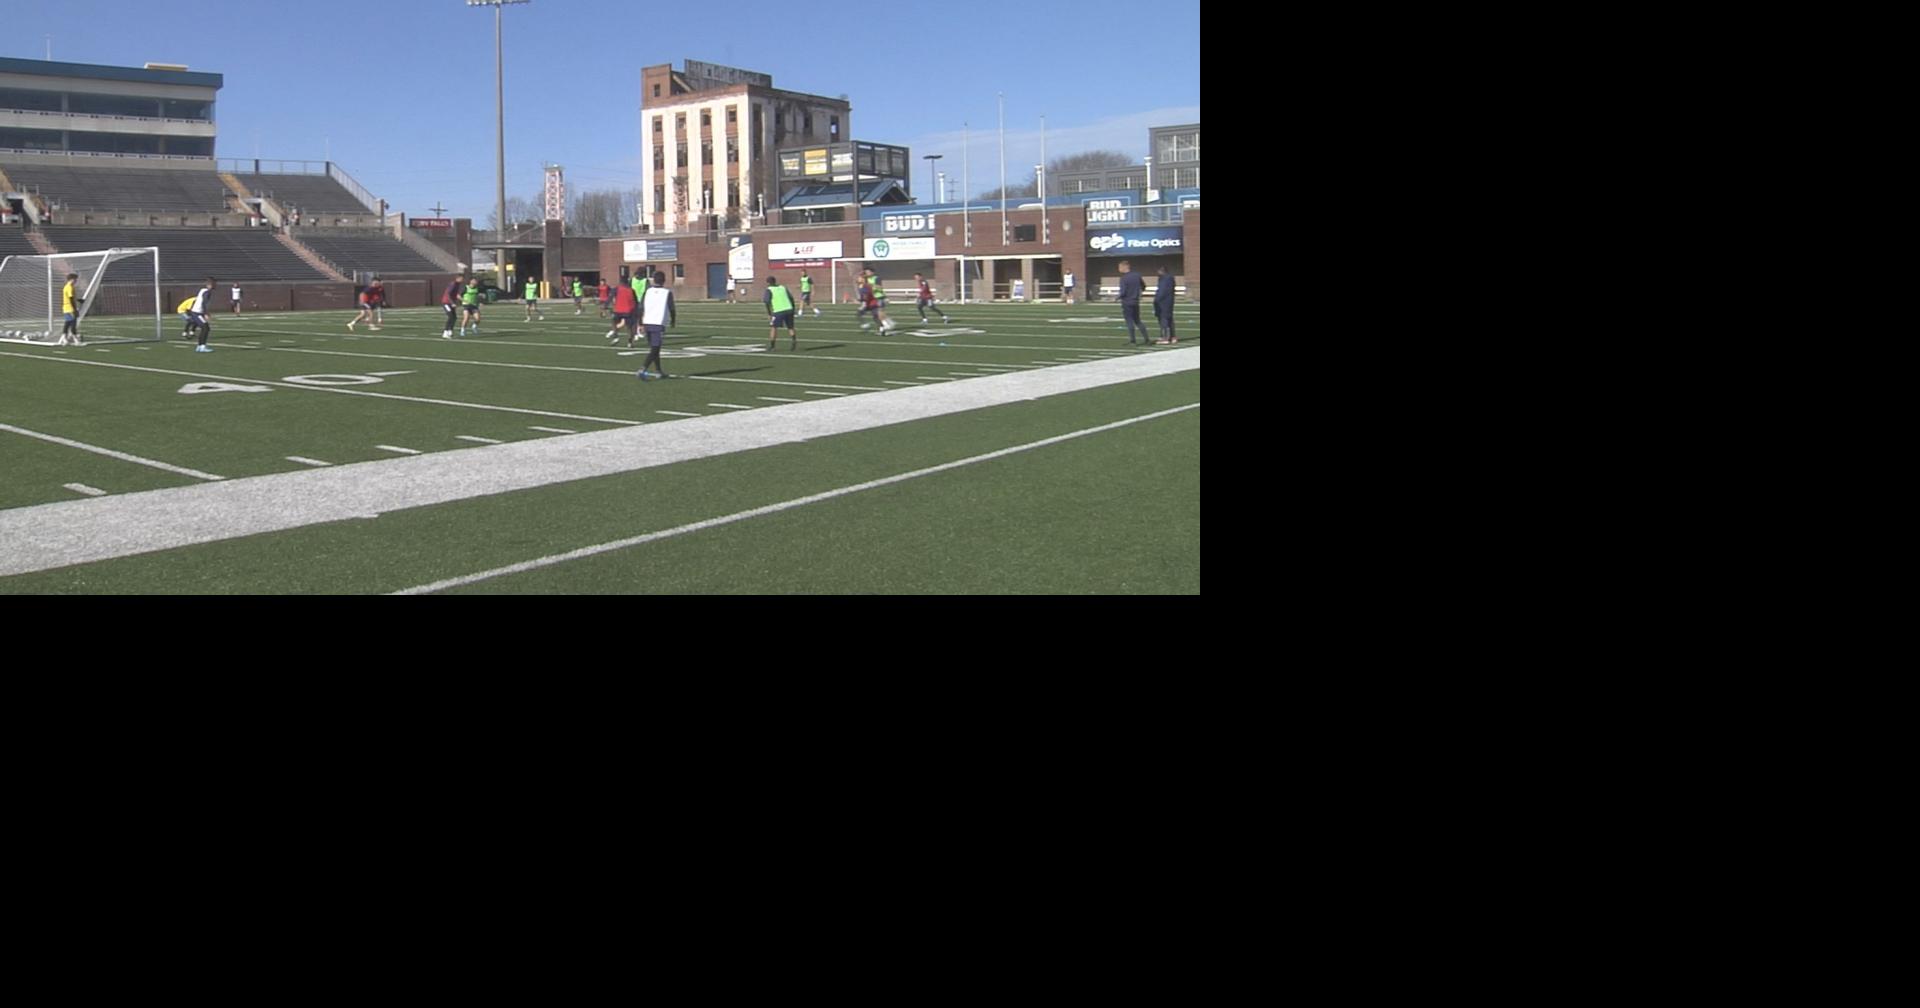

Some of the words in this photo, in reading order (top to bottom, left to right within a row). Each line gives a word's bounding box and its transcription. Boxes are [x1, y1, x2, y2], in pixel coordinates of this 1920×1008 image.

[1087, 209, 1128, 222] LIGHT
[884, 215, 926, 232] BUD
[1127, 239, 1150, 248] Fiber
[1150, 238, 1182, 249] Optics
